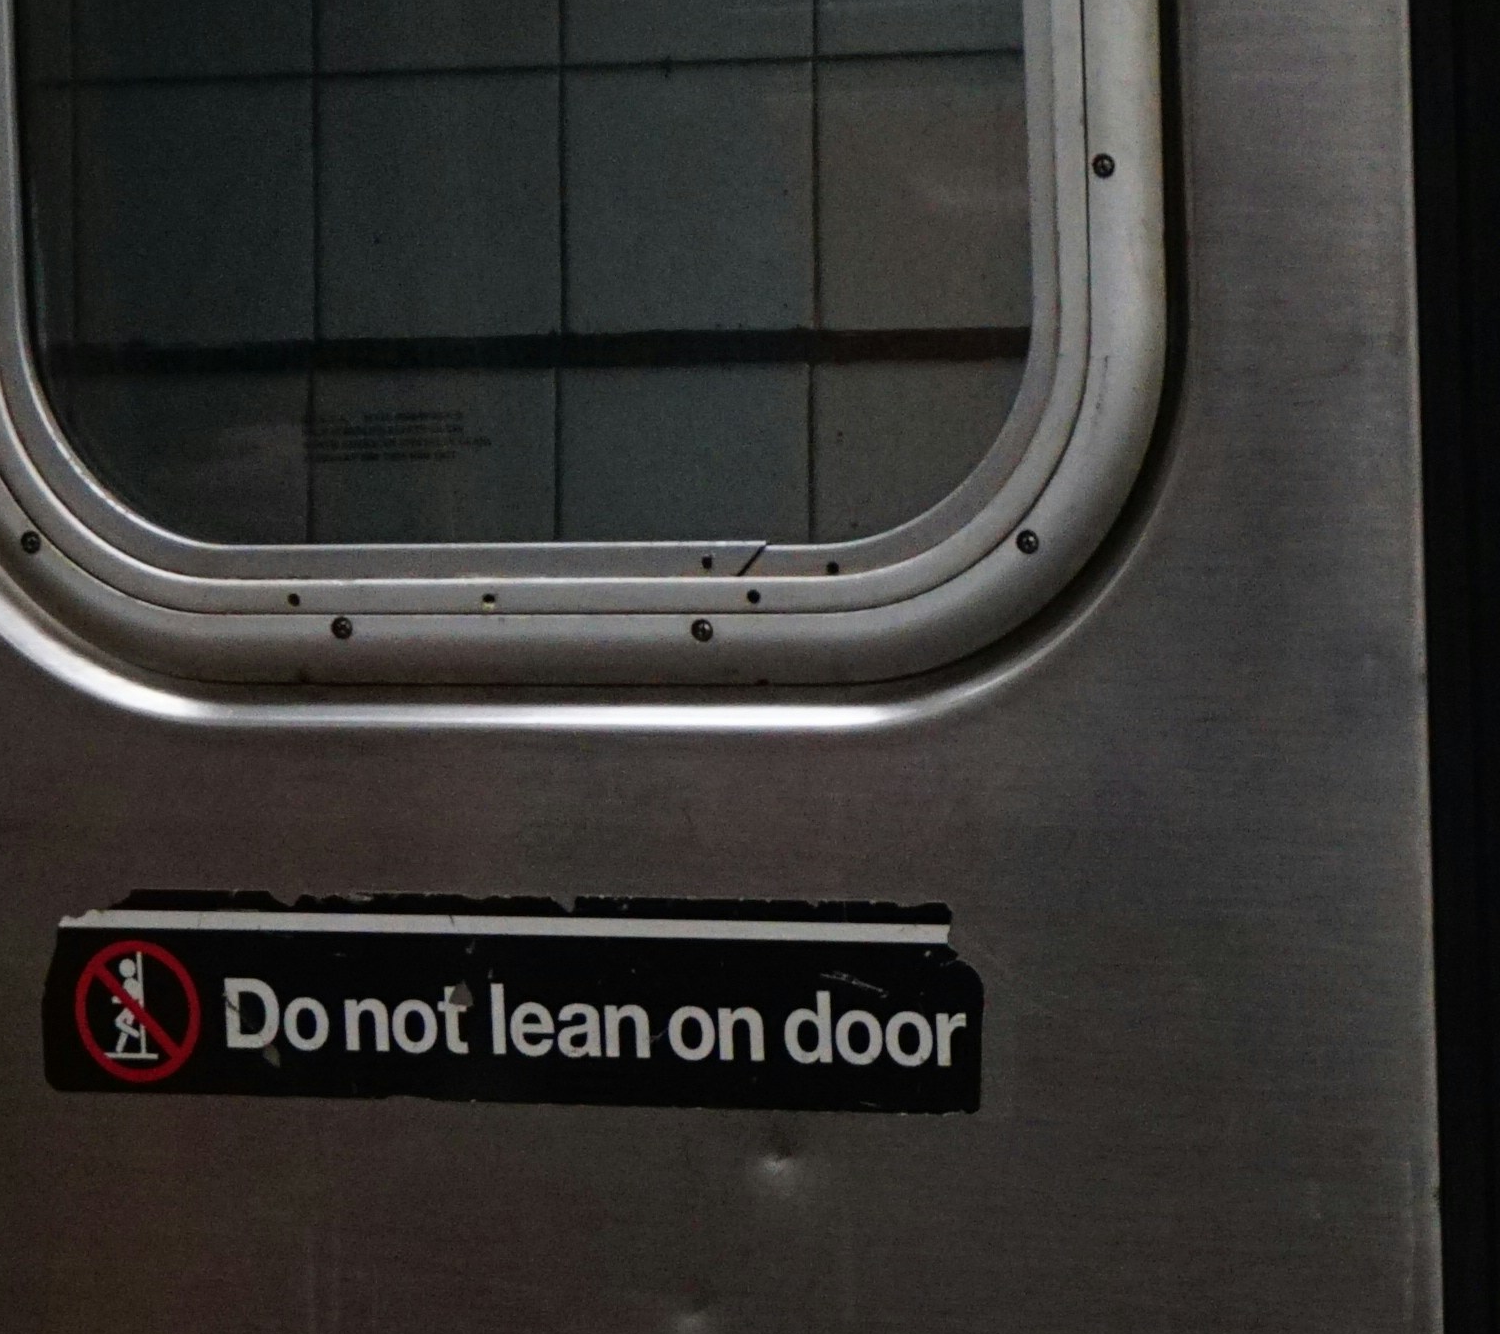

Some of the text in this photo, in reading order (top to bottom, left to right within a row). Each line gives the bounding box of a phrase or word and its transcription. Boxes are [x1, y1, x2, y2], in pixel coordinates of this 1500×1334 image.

[223, 977, 967, 1067] Do not lean on door
